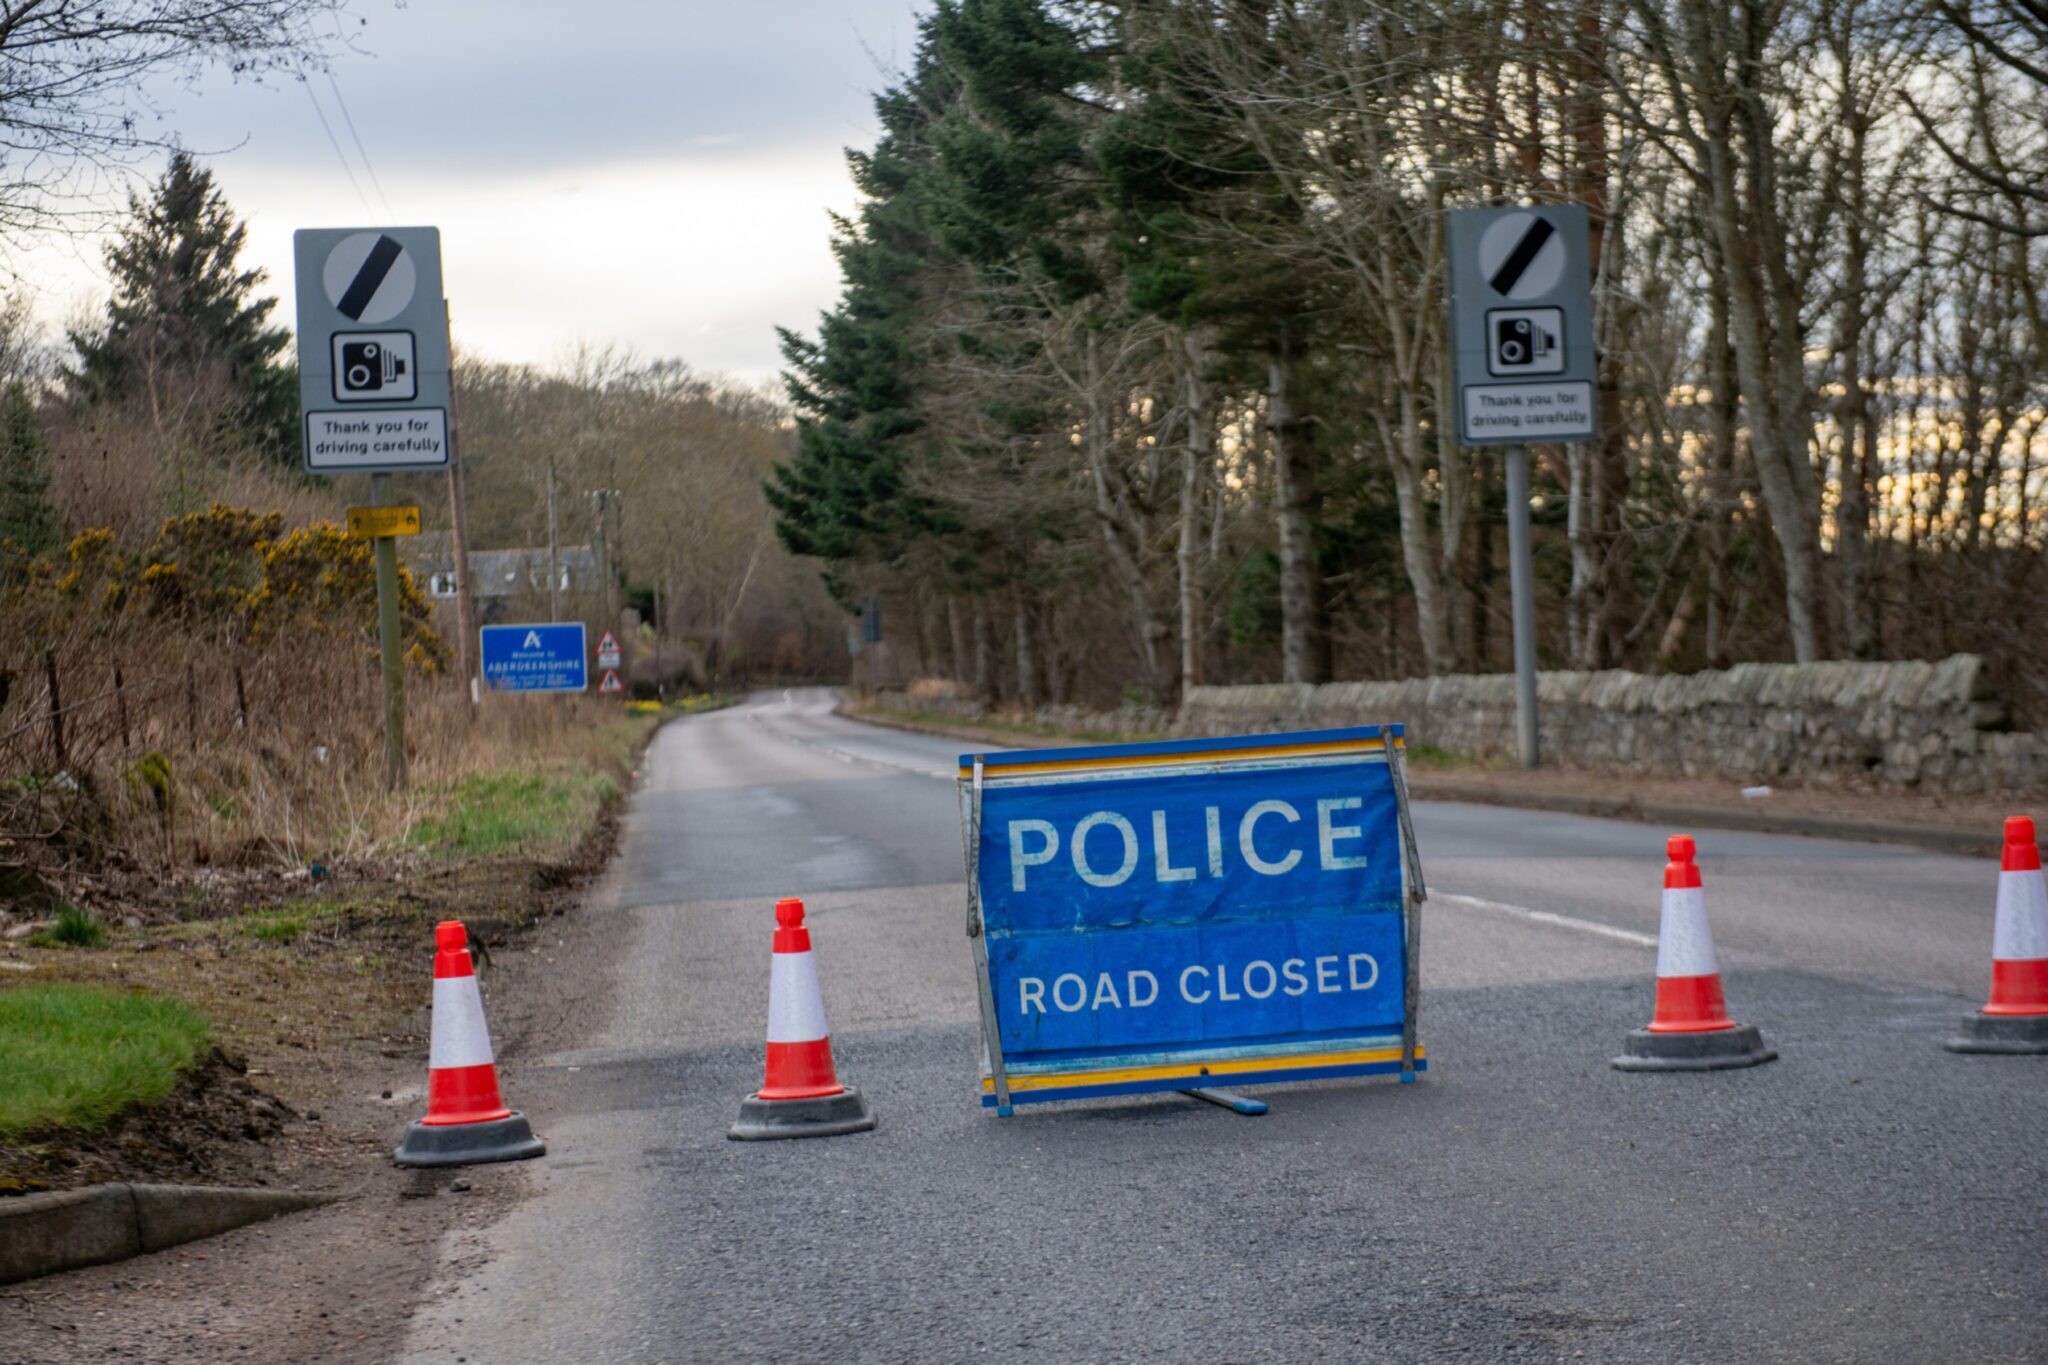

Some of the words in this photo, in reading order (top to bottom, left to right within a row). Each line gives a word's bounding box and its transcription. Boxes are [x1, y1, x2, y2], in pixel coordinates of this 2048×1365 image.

[1479, 394, 1522, 407] Thank
[1526, 395, 1552, 407] you
[1556, 392, 1577, 404] for
[324, 420, 370, 434] Thank
[375, 422, 402, 434] you
[408, 418, 430, 431] for
[1472, 414, 1521, 427] driving
[1525, 410, 1588, 424] carefully
[315, 440, 368, 455] driving
[373, 437, 441, 453] carefully
[488, 659, 580, 672] ABERDEENSHIRE
[1007, 796, 1368, 893] POLICE
[1019, 969, 1160, 1015] ROAD
[1179, 952, 1379, 1004] CLOSED
